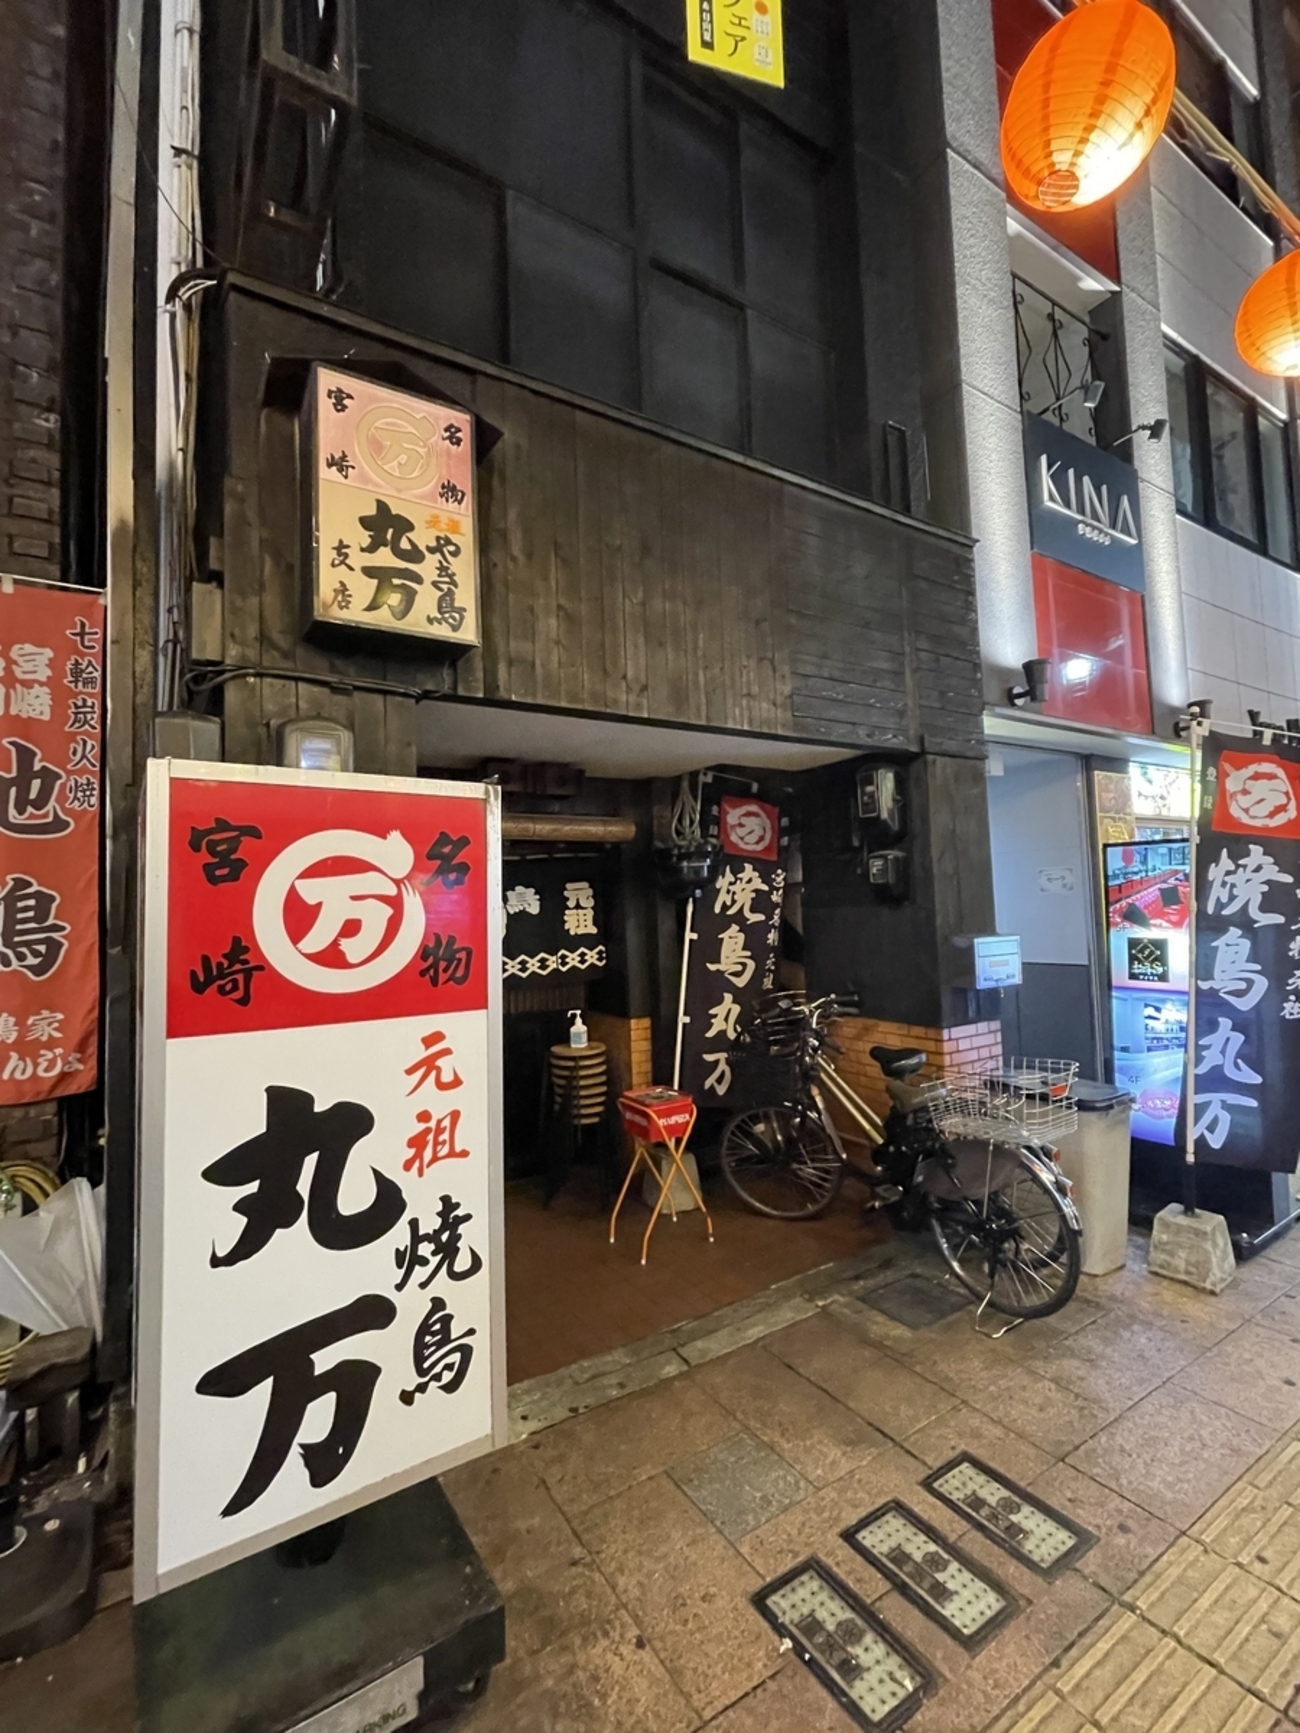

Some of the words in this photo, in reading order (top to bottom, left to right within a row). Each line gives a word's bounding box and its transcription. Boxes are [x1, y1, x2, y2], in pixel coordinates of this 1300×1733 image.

[326, 386, 356, 479] 宮崎
[439, 423, 466, 505] 名物
[329, 538, 356, 611] 支店
[358, 498, 426, 621] 丸万
[425, 534, 467, 632] やき鳥
[64, 616, 101, 809] 七輪炭火焼
[188, 817, 265, 1007] 宮崎
[419, 831, 473, 988] 名物
[563, 881, 598, 936] 元祖
[703, 863, 770, 1096] 焼鳥丸万
[1194, 844, 1294, 1149] 焼鳥丸万
[403, 1030, 471, 1178] 元祖
[194, 1084, 407, 1519] 丸万
[394, 1194, 483, 1407] 焼鳥
